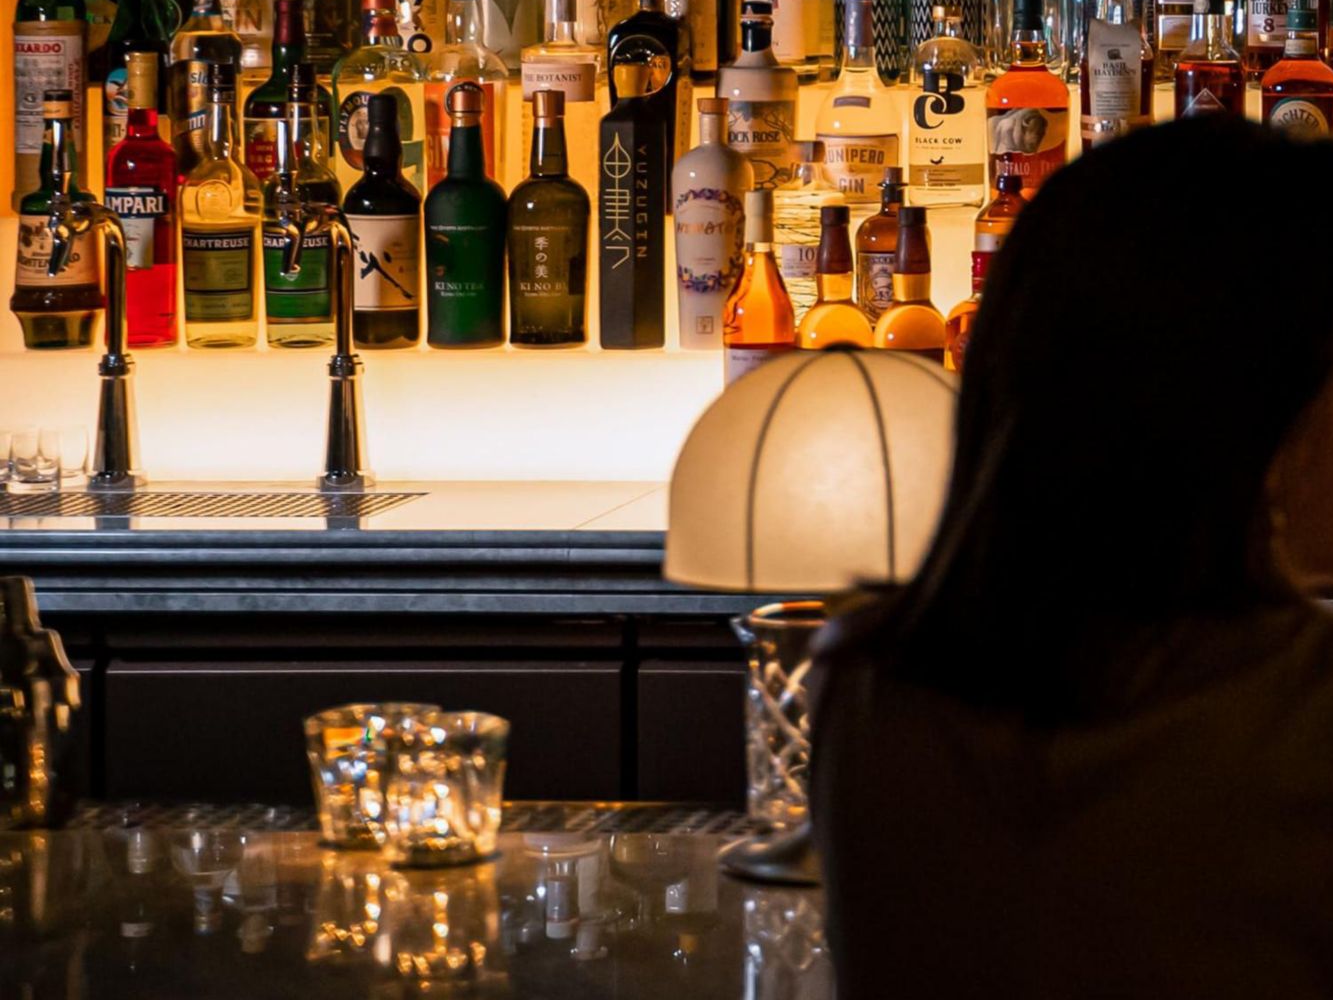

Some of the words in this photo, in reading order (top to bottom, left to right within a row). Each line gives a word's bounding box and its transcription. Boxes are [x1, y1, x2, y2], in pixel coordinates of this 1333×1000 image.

[1250, 0, 1289, 16] TURKEY
[1262, 18, 1275, 33] 8
[535, 74, 584, 82] BOTANIST
[339, 94, 371, 134] PLYMOU
[730, 131, 750, 144] OCK
[751, 131, 780, 144] ROSE
[943, 136, 963, 144] COW
[824, 148, 885, 165] JUNIPERO
[995, 159, 1031, 177] BFFALO
[838, 178, 865, 194] GIN
[105, 195, 166, 215] AMPARI
[183, 236, 249, 249] CHARTREUSE
[263, 235, 329, 248] CHAREUSE
[798, 247, 815, 262] 10
